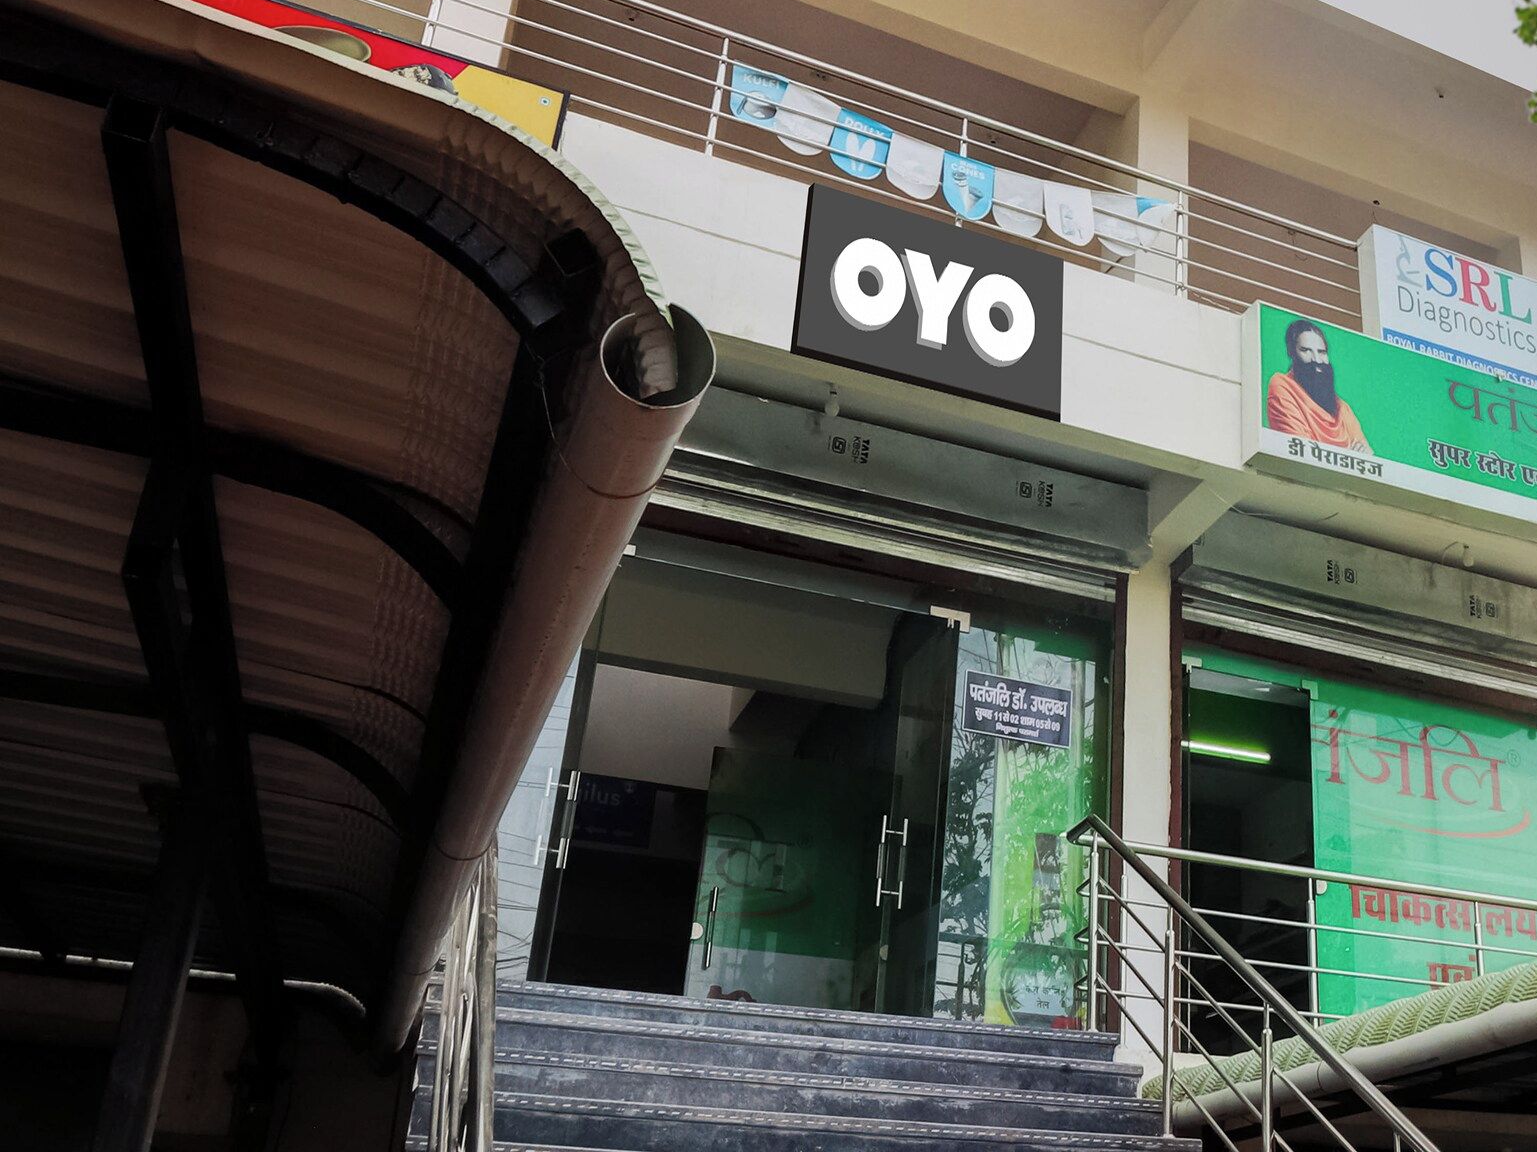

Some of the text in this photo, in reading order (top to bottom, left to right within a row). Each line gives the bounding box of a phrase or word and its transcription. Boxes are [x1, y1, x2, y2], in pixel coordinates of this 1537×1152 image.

[830, 237, 1036, 368] OYO
[1424, 248, 1532, 325] SRL
[1398, 285, 1537, 354] Diagnostics
[1386, 333, 1417, 350] ROYAL
[1287, 437, 1383, 477] डी पैराडाइज
[1428, 438, 1471, 468] सुपर
[1475, 450, 1516, 481] स्टोर
[969, 680, 1011, 707] पतंजलि
[1030, 695, 1068, 717] उपलब्ध
